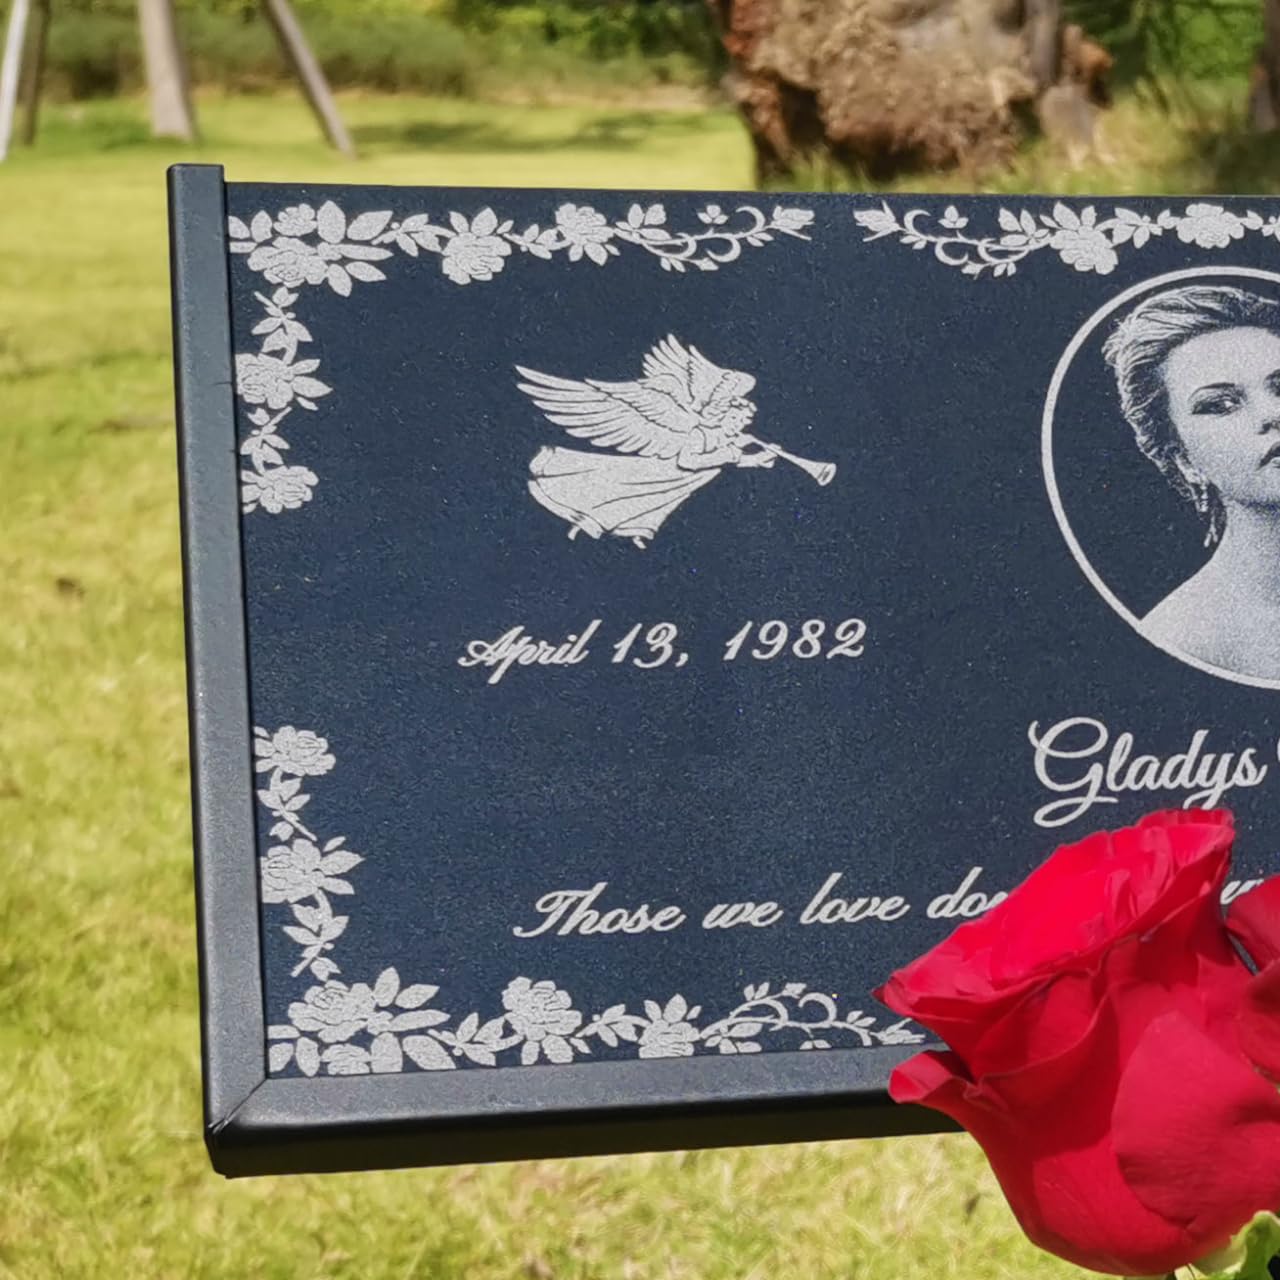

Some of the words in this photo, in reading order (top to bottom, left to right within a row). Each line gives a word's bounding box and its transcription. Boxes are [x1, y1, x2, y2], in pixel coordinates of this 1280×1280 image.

[458, 620, 602, 684] April
[612, 623, 688, 668] 13,
[724, 619, 866, 660] 1982
[1028, 716, 1267, 828] Gladys
[513, 882, 686, 937] Those
[702, 902, 784, 929] we
[800, 873, 910, 924] love
